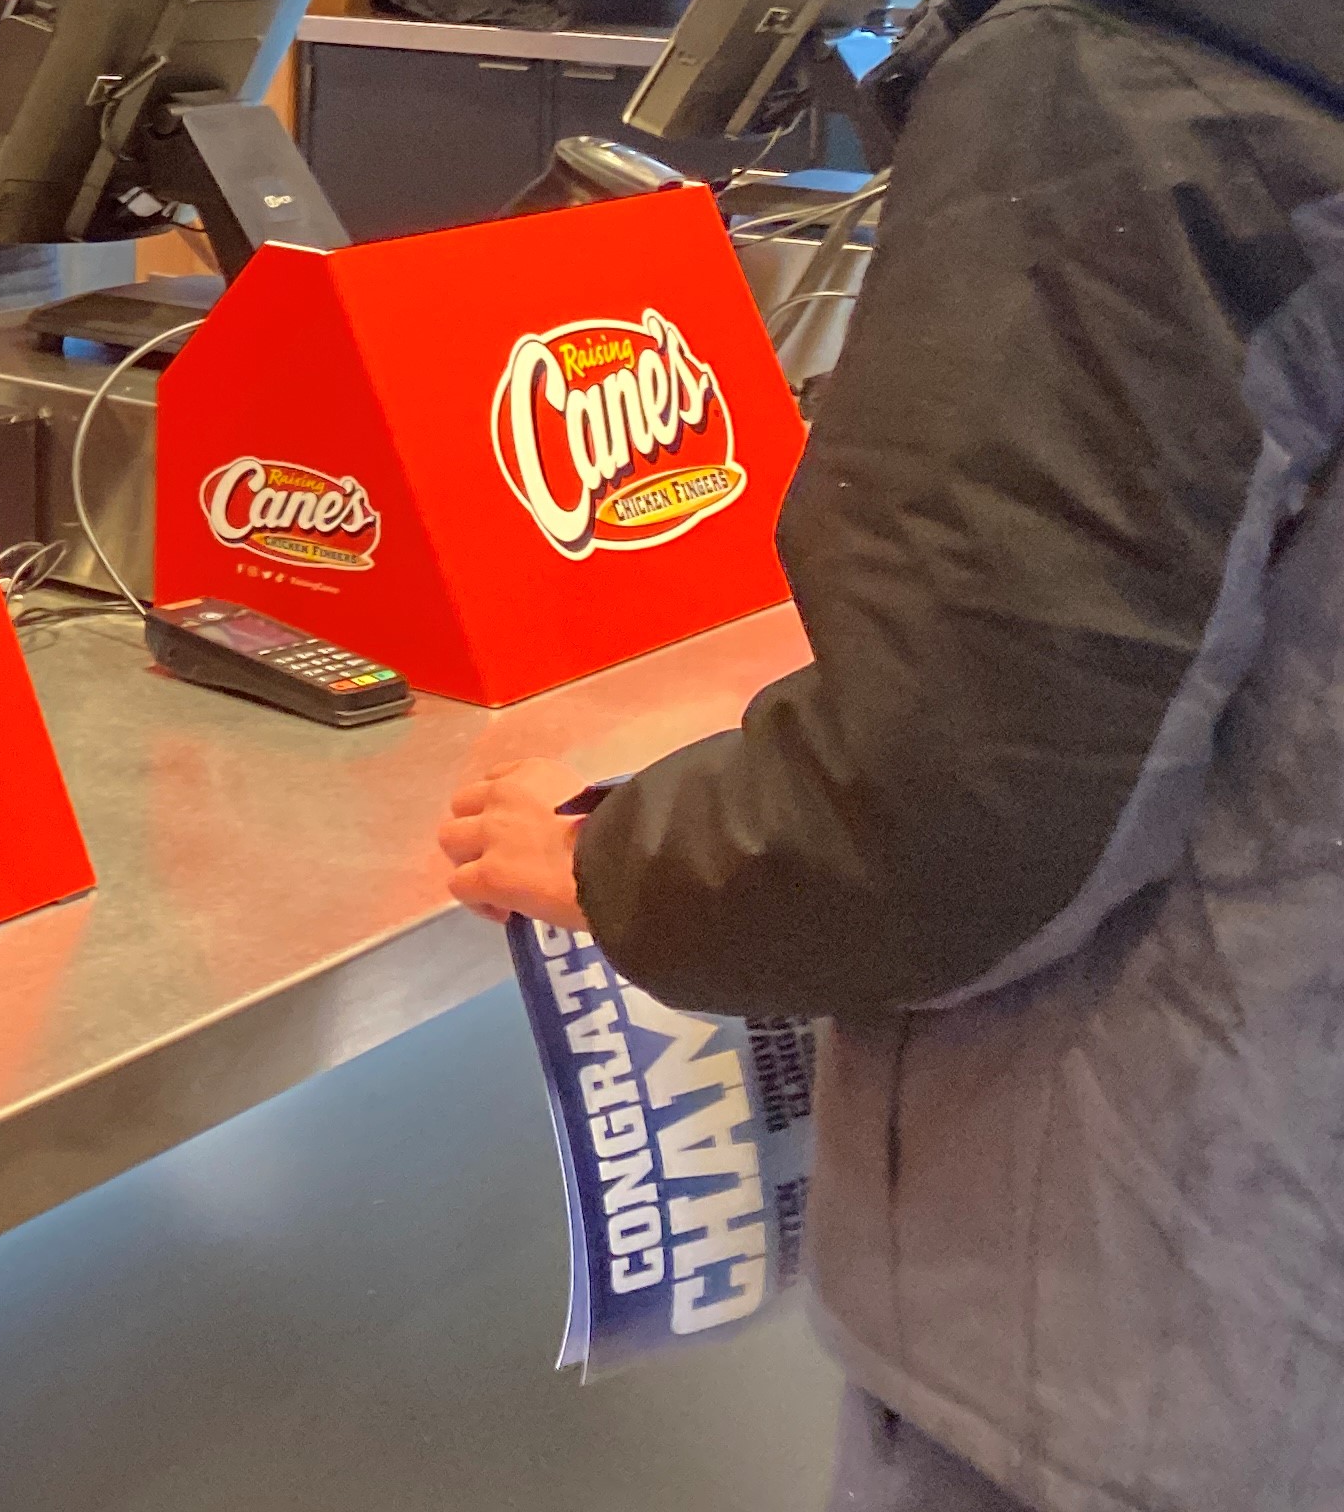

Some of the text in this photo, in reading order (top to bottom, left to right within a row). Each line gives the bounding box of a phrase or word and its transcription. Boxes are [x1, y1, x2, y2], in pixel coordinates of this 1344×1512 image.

[560, 334, 636, 381] Raising
[511, 309, 710, 545] Cane's
[211, 458, 375, 540] Cane's
[267, 469, 326, 494] Raising
